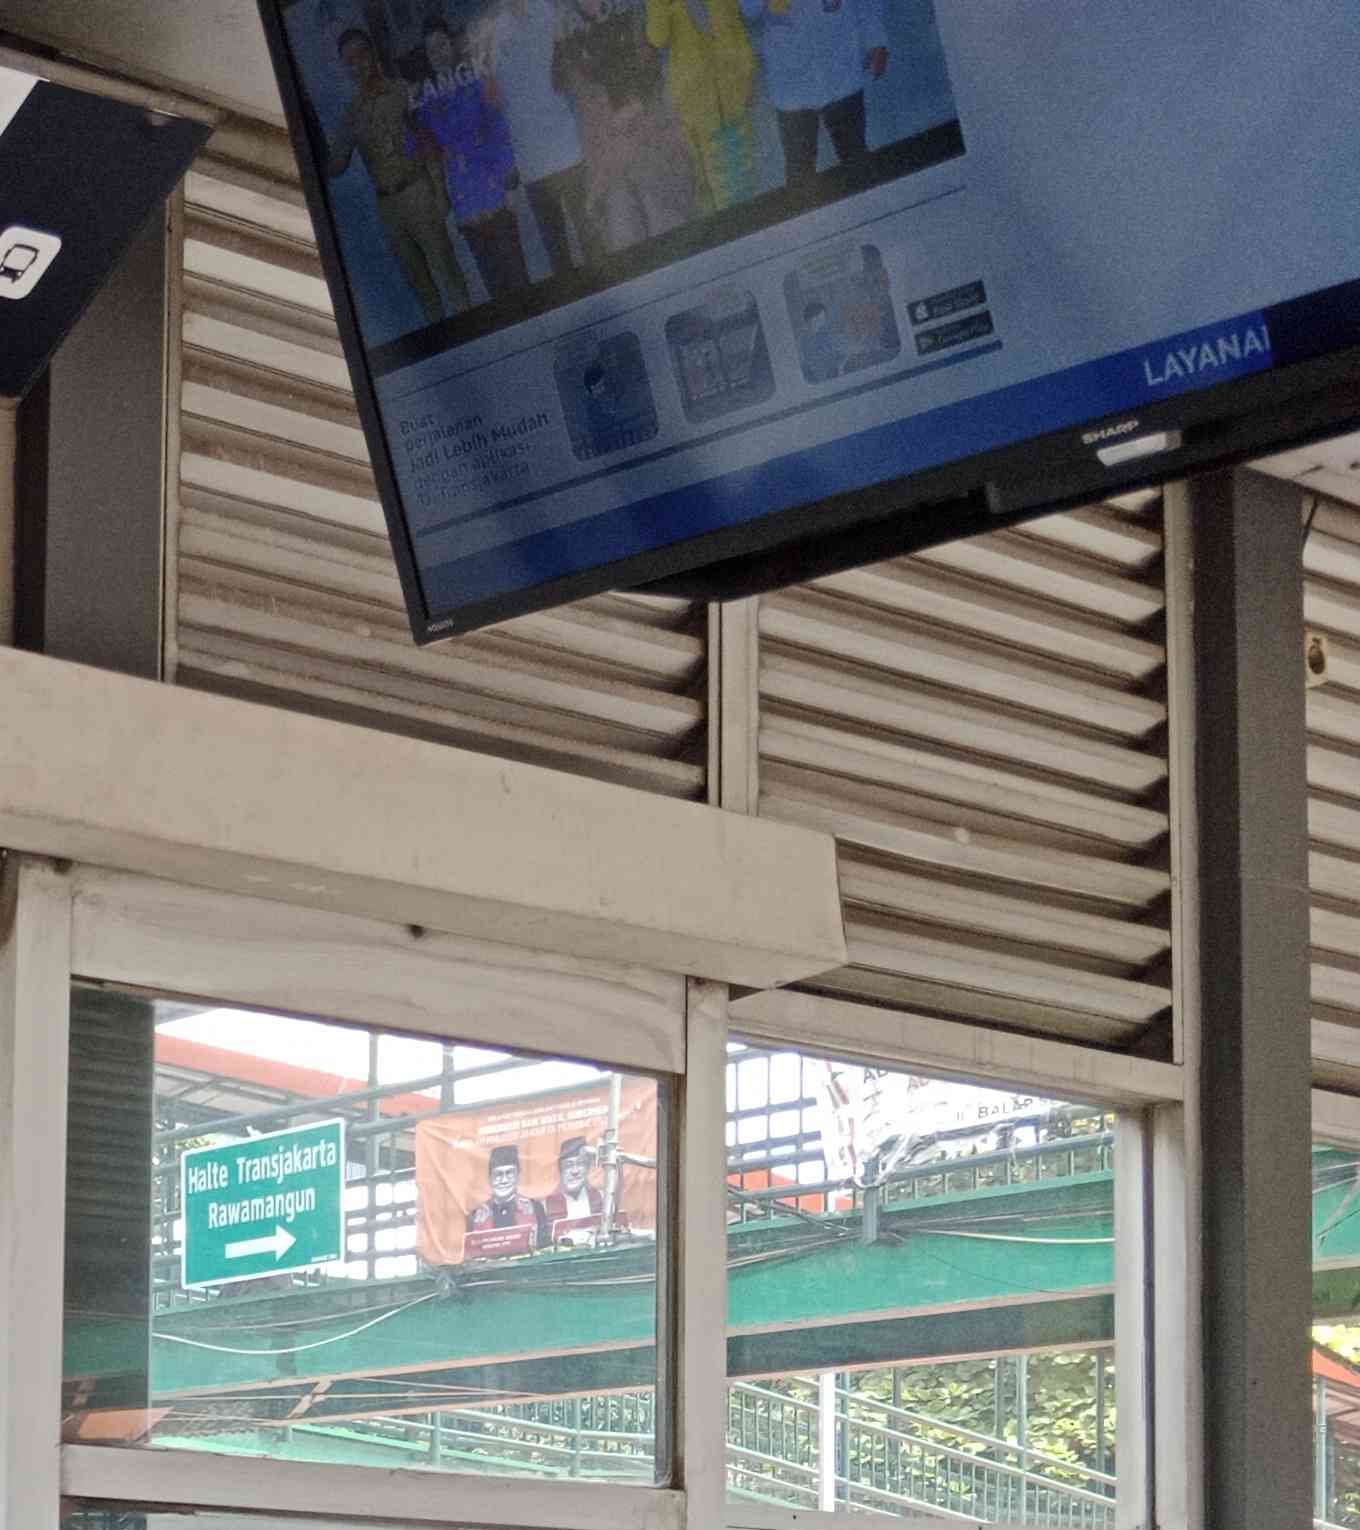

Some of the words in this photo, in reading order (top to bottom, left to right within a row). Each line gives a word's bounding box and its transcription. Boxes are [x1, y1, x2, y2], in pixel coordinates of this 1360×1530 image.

[490, 412, 550, 442] Mudah
[1082, 419, 1139, 445] SHARP
[188, 1161, 228, 1194] Halte
[235, 1138, 337, 1184] Transjakarta
[208, 1187, 316, 1230] Rawamangun
